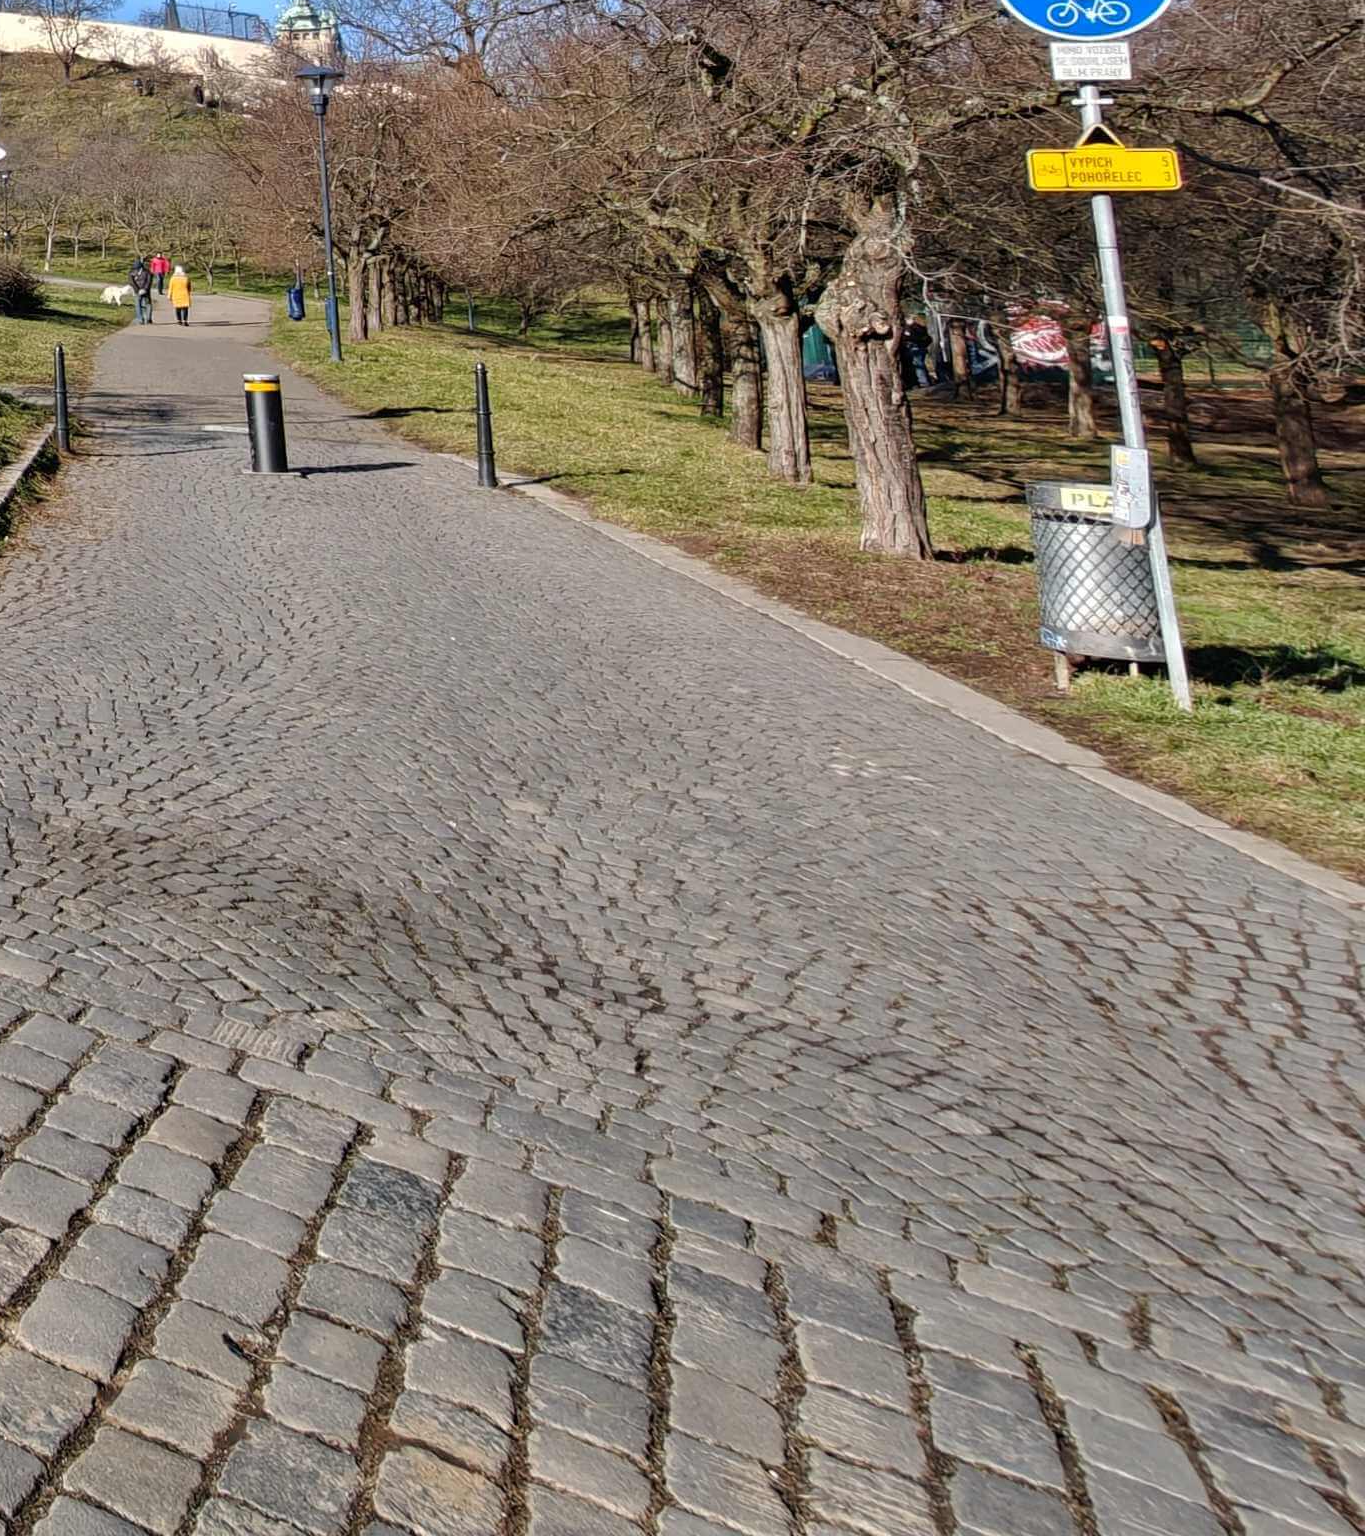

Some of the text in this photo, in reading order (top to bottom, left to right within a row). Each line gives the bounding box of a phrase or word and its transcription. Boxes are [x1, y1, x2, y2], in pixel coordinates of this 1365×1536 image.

[1069, 156, 1169, 169] VYPICH 5
[1070, 169, 1172, 183] POHOŘELEC 3
[1070, 493, 1113, 508] PLA
